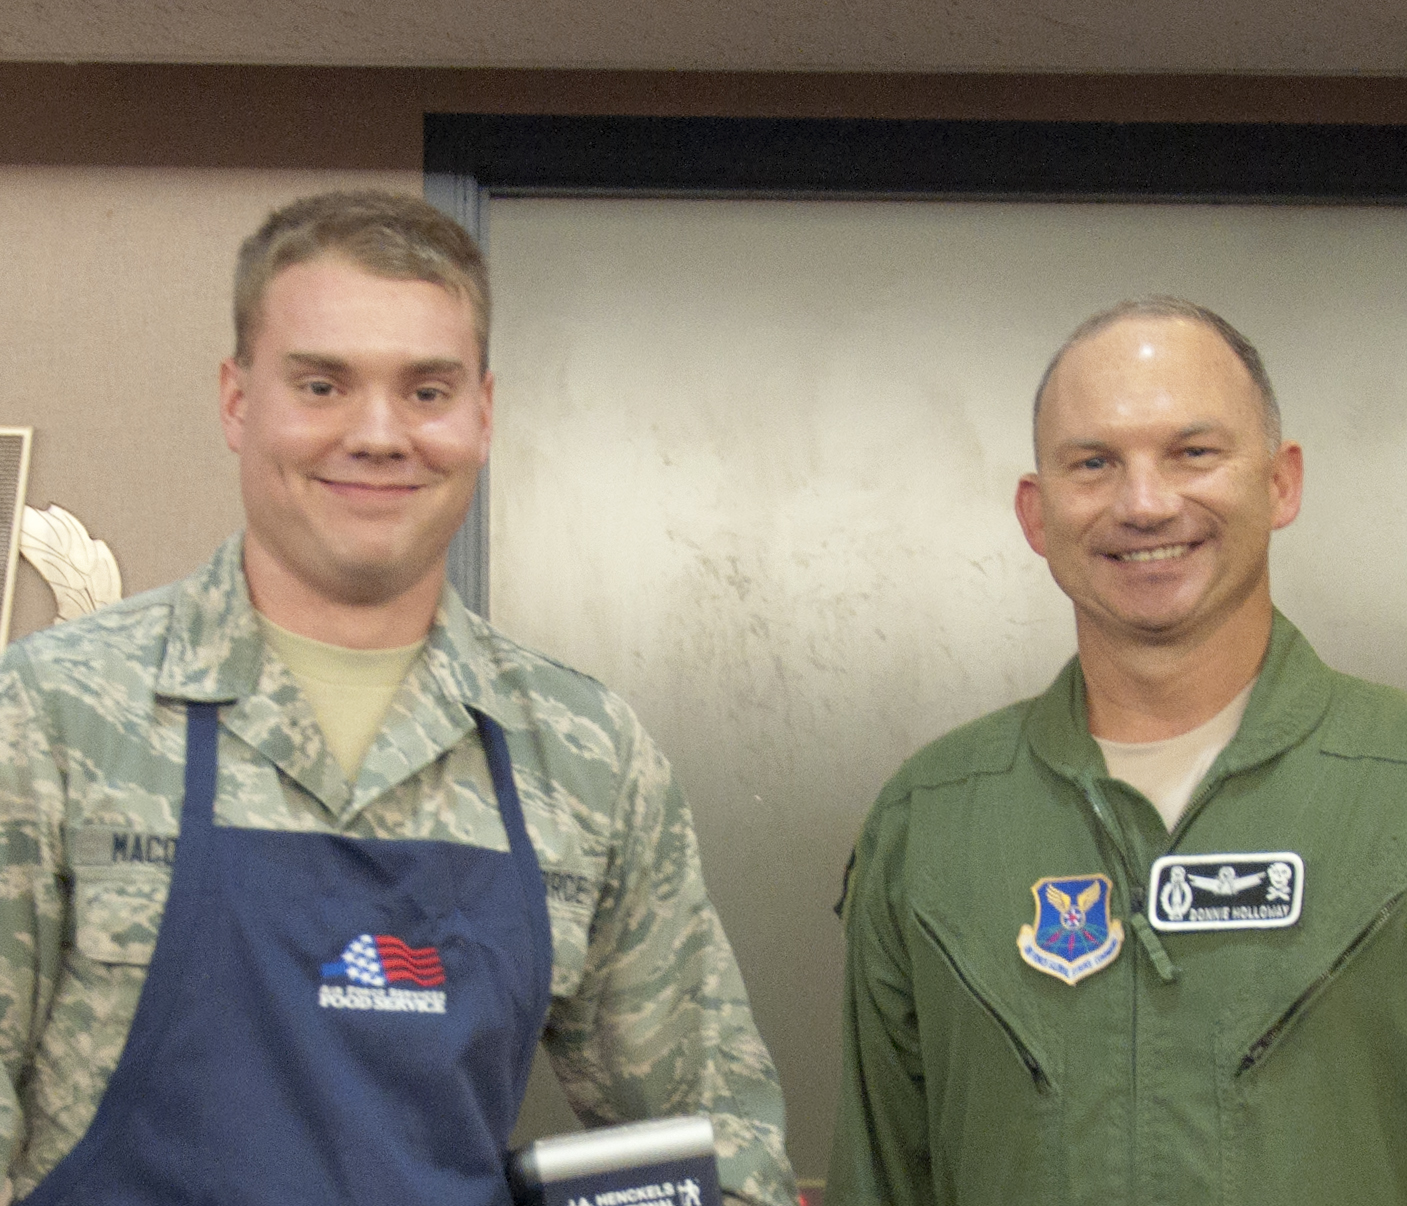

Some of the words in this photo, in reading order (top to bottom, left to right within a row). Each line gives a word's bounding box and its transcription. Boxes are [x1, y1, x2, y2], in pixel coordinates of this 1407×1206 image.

[1189, 906, 1230, 922] DONNIE
[1231, 903, 1290, 919] HOLLOWAY
[319, 994, 372, 1010] FOOD
[372, 996, 447, 1014] SERVICE
